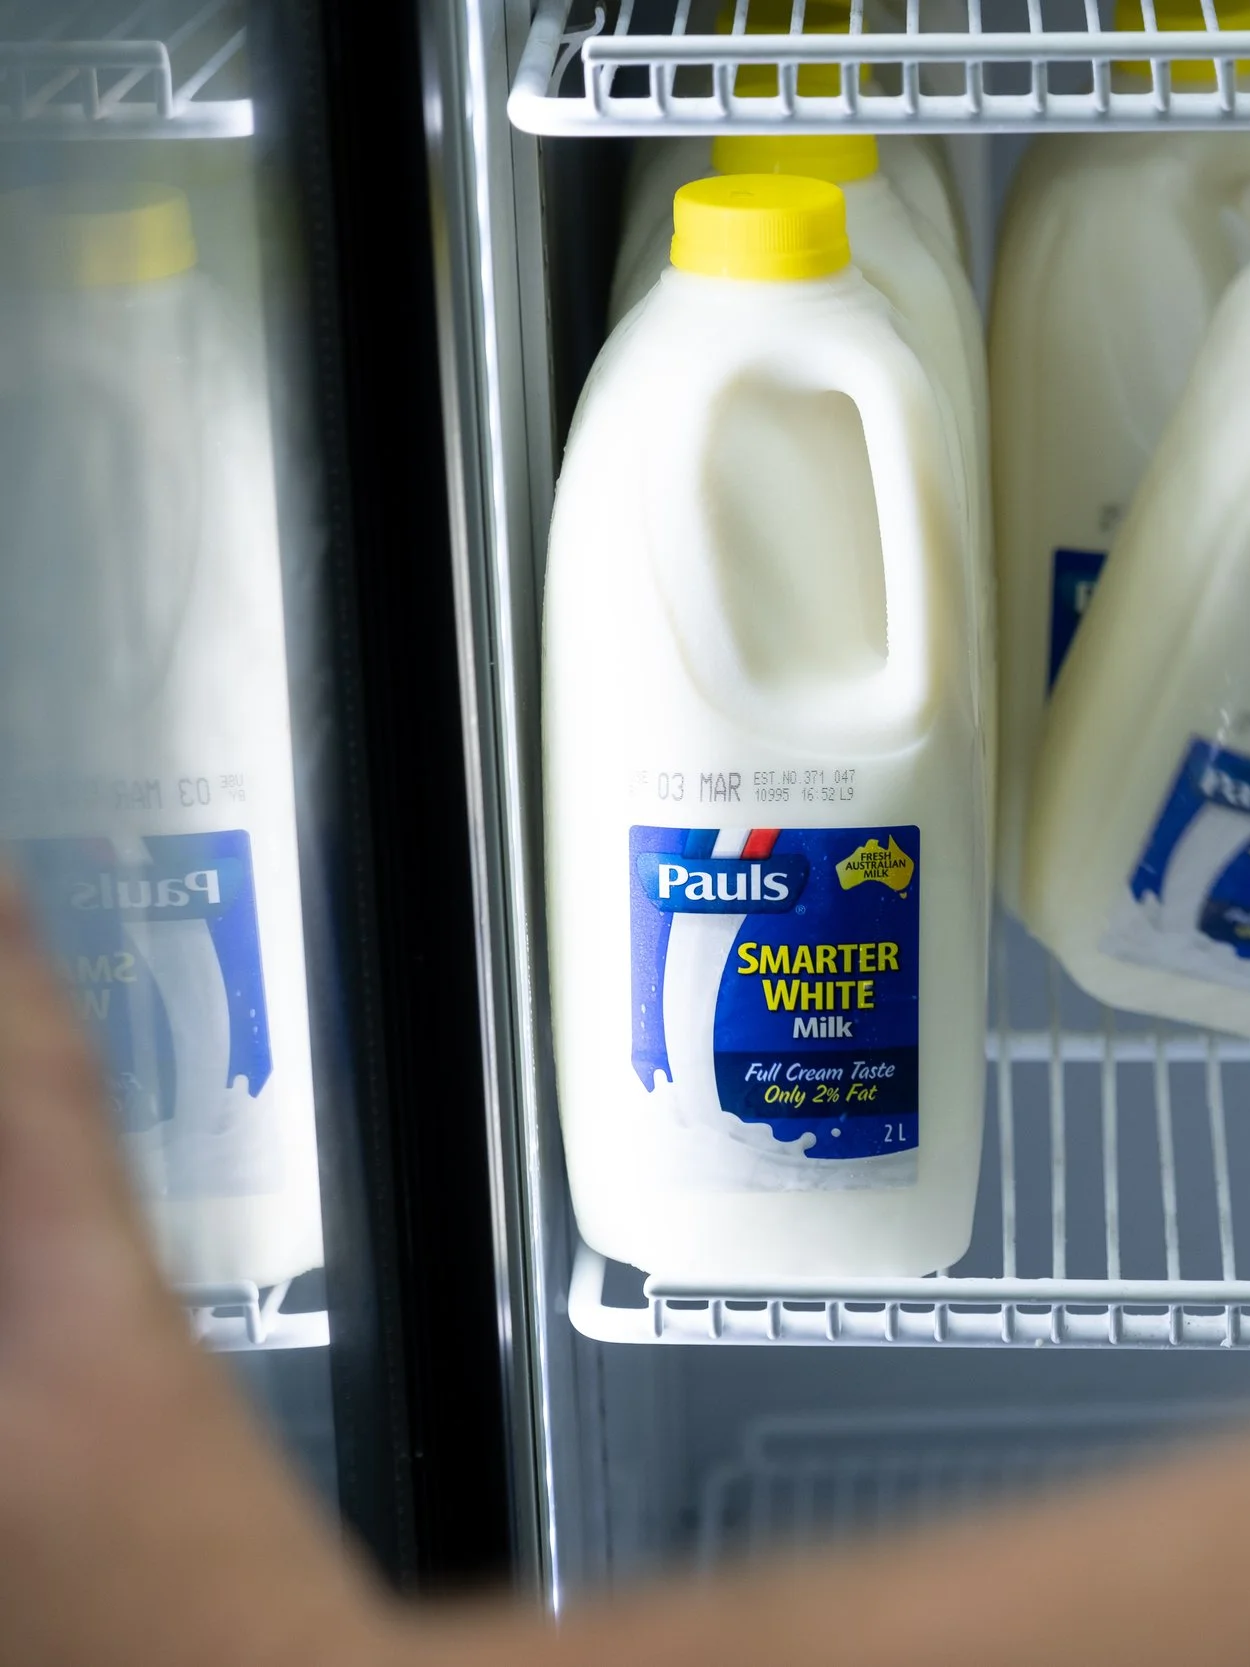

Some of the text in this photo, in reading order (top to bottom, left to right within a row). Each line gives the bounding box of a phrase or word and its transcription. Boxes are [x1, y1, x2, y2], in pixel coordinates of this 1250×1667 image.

[657, 772, 685, 802] 03
[699, 772, 742, 802] MAR
[834, 768, 856, 784] 047
[755, 787, 790, 802] 10995
[845, 859, 907, 871] AUSTRALIAN
[860, 852, 892, 862] FRESH
[657, 863, 789, 902] Pauls
[863, 869, 890, 879] MILK
[737, 942, 899, 975] SMARTER
[761, 979, 875, 1012] WHITE
[792, 1016, 853, 1039] Milk
[744, 1061, 896, 1082] Full Cream Taste
[764, 1082, 879, 1109] Only 2% Fat
